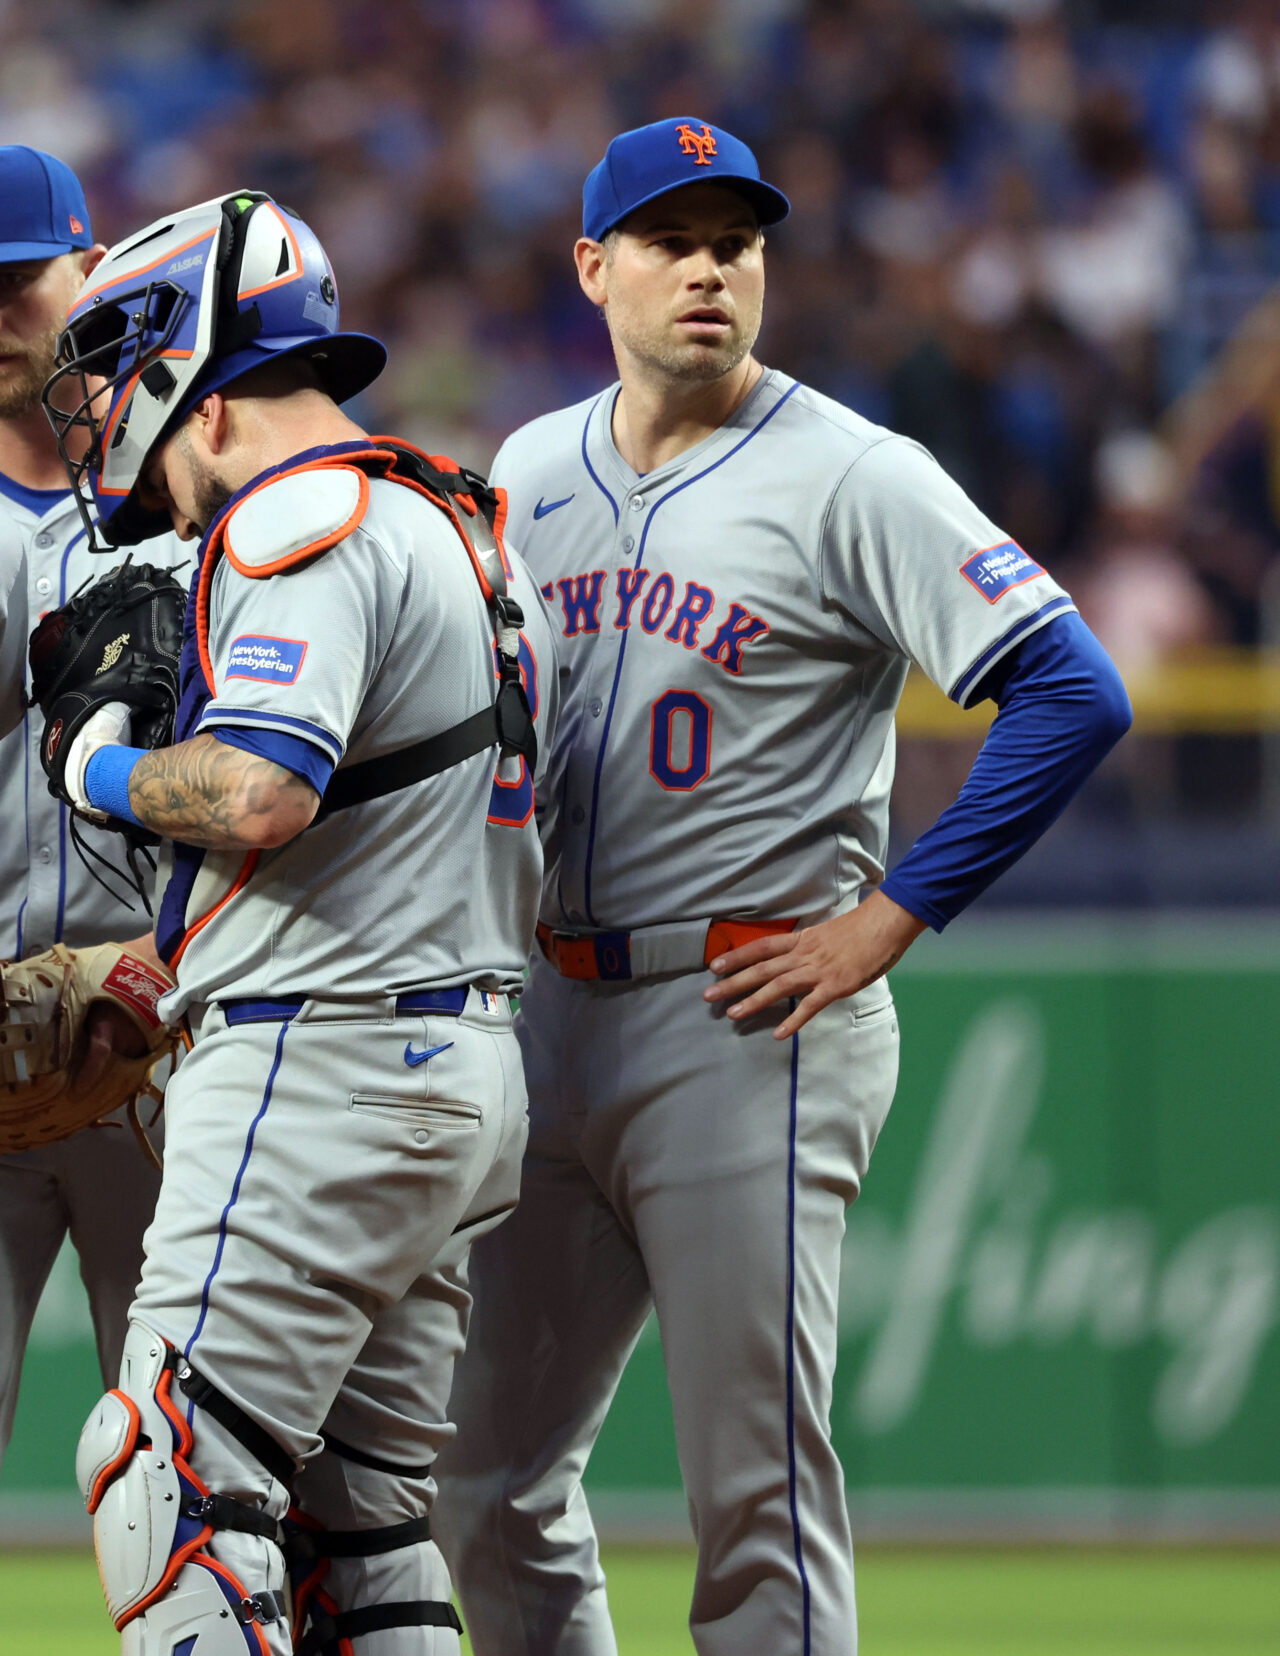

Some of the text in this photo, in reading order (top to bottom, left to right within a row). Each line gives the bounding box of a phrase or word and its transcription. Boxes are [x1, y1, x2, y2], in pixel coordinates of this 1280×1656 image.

[231, 645, 282, 658] NewYork-
[540, 567, 770, 676] W YORK
[228, 655, 294, 673] Presbyterian
[649, 688, 713, 792] 0
